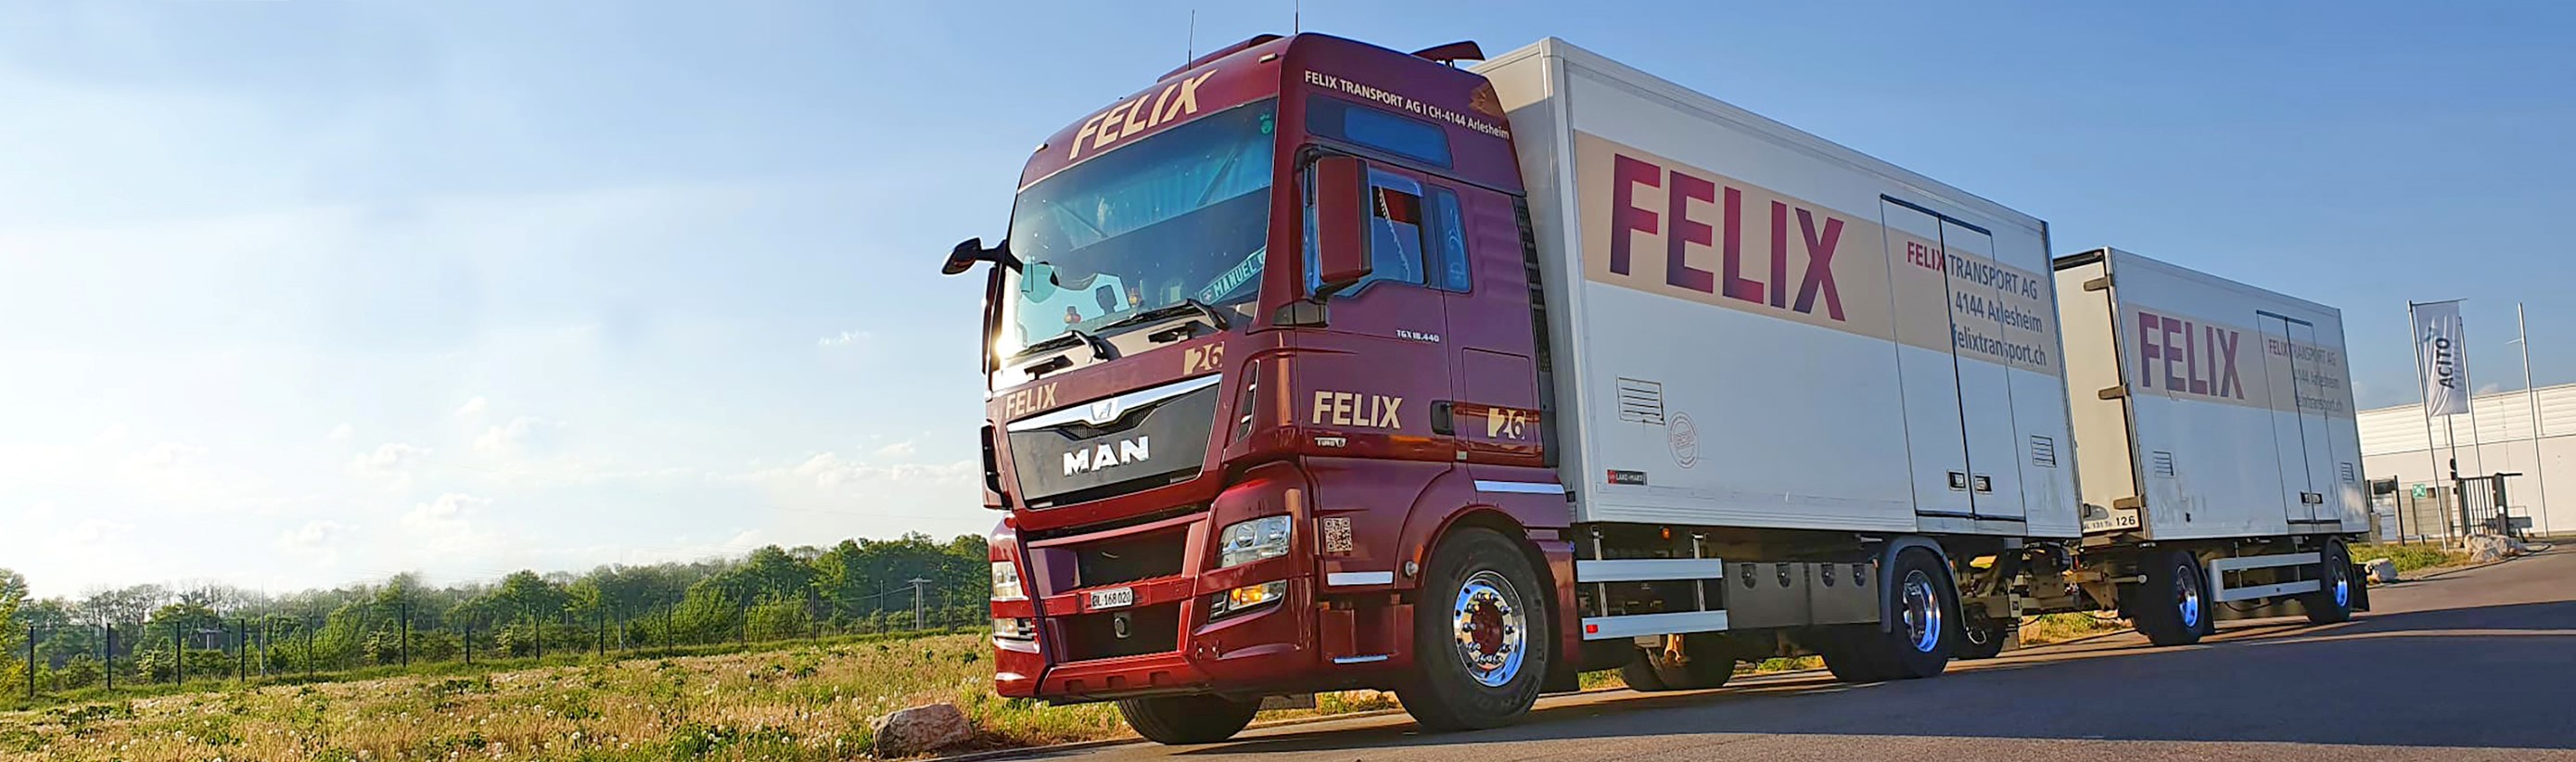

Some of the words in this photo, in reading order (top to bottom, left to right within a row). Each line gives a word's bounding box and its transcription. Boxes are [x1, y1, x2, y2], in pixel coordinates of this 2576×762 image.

[1068, 69, 1218, 160] FELIX
[1305, 70, 1337, 90] FELIX
[1339, 80, 1403, 108] TRANSPORT
[1405, 98, 1422, 113] AG
[1429, 106, 1466, 126] CH-4144
[1467, 117, 1511, 139] Arlesheim
[1609, 153, 1846, 322] FELIX
[1213, 259, 1256, 298] MANUEL
[1907, 241, 1944, 272] FELIX
[1949, 254, 2019, 294] TRANSPORT
[2021, 280, 2037, 299] AG
[1956, 291, 1984, 318] 4144
[1988, 300, 2043, 333] Arlesheim
[1194, 346, 1223, 370] 26
[2138, 311, 2245, 400] FELIX
[2435, 337, 2455, 389] ACITO
[1005, 382, 1058, 417] FELIX
[1312, 391, 1403, 429] FELIX
[1498, 409, 1525, 439] 26
[1063, 436, 1149, 476] MAN
[2116, 515, 2136, 526] 126
